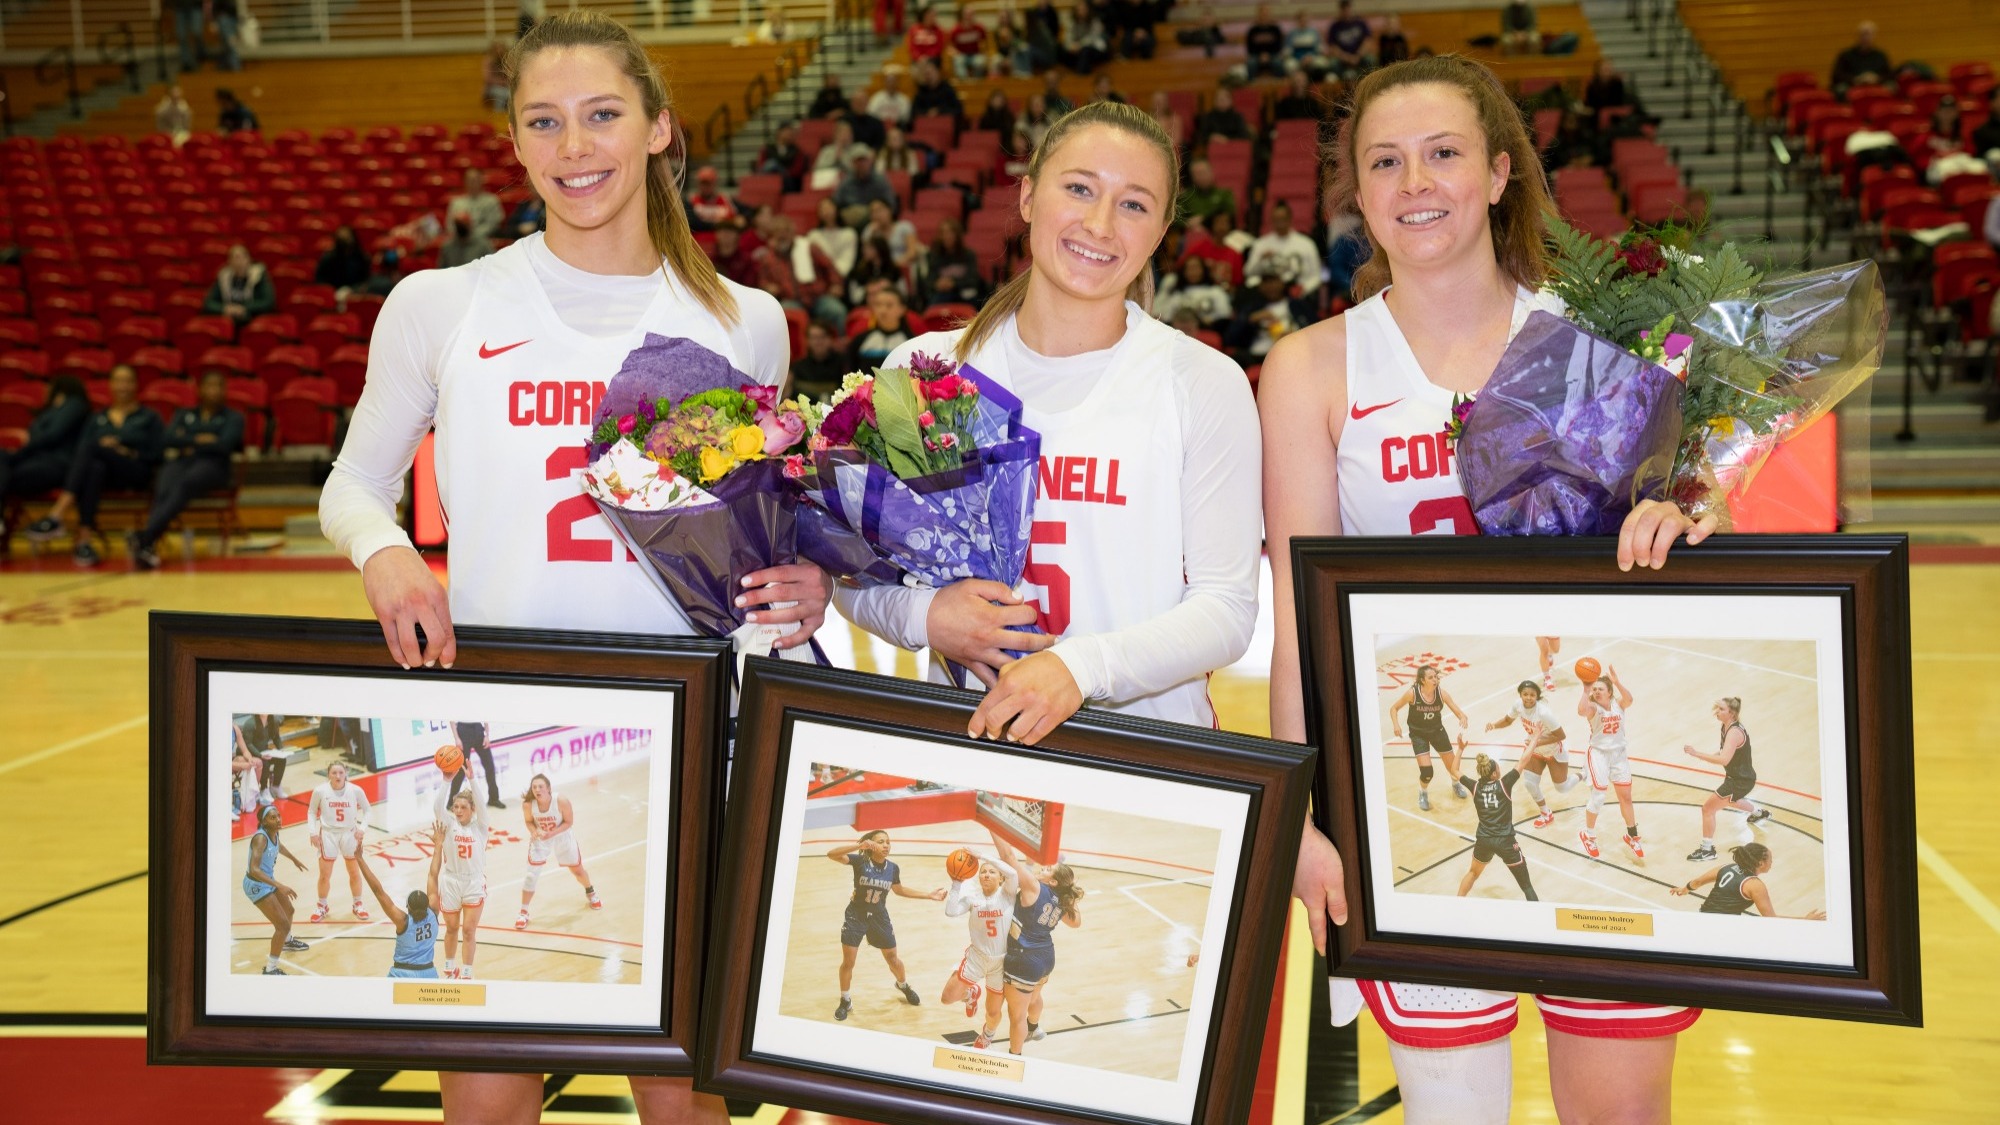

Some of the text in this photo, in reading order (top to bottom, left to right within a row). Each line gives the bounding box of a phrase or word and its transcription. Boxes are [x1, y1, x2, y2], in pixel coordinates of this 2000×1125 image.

[546, 446, 638, 562] 2
[1022, 521, 1070, 636] 5
[1423, 712, 1435, 720] 10
[1602, 722, 1620, 734] 22
[531, 743, 563, 773] GO
[1482, 792, 1499, 808] 14
[336, 809, 345, 822] 5
[457, 845, 473, 859] 21
[859, 875, 893, 891] CLARION
[977, 909, 1004, 918] CORNELL
[1572, 913, 1636, 925] Shannon Mulroy
[415, 922, 433, 943] 23
[985, 919, 998, 938] 5
[957, 1064, 974, 1072] Class
[968, 1056, 1009, 1069] McNicholas
